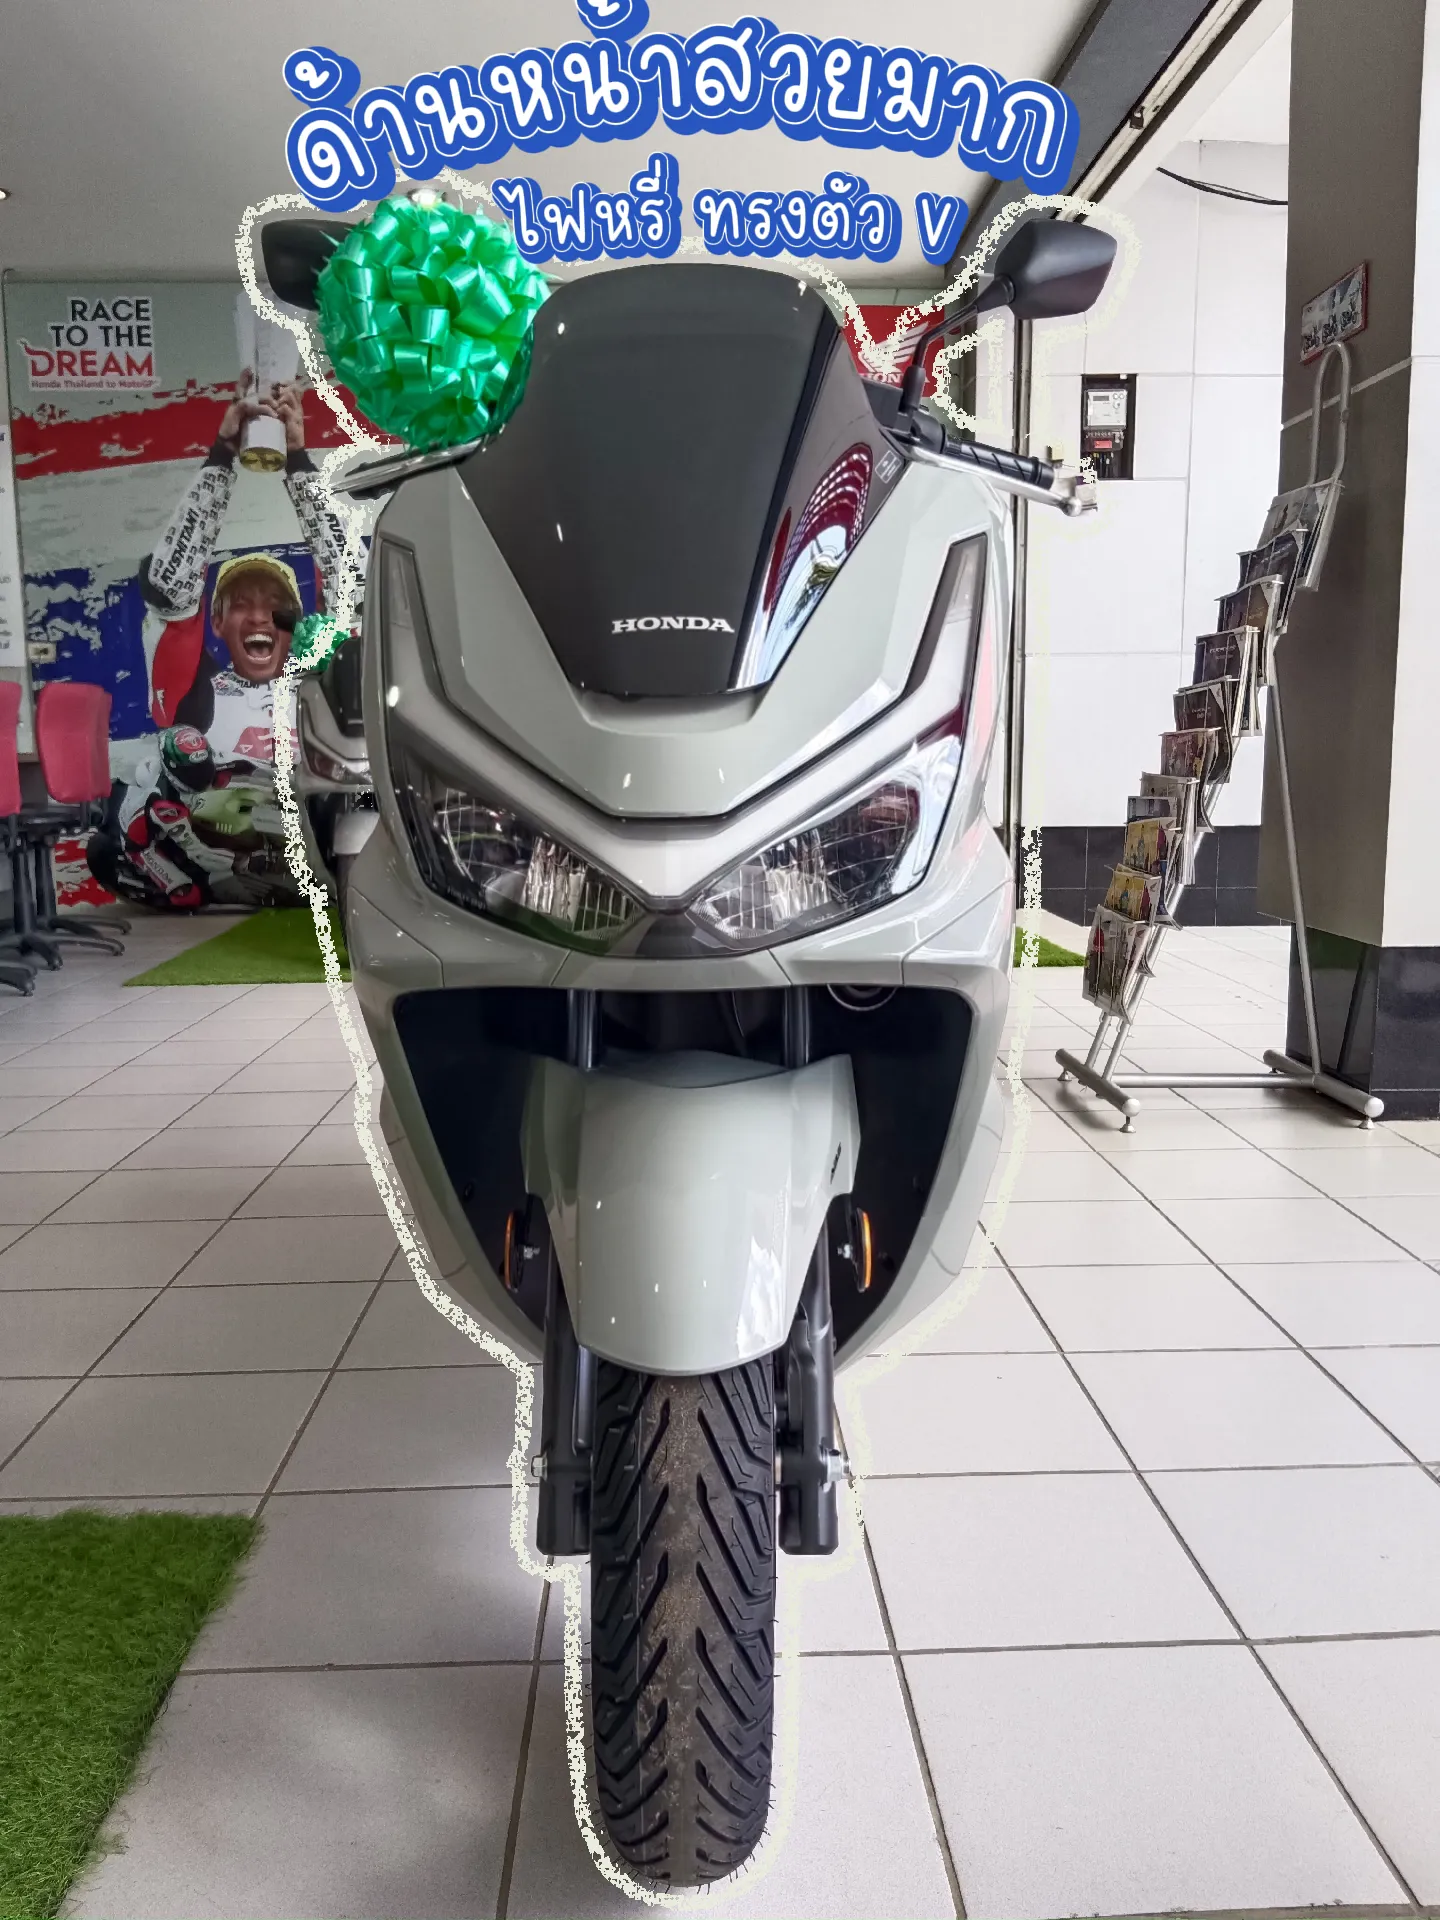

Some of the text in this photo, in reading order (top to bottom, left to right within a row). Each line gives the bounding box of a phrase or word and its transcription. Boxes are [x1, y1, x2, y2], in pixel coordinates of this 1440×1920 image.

[71, 299, 151, 322] RACE
[50, 324, 152, 347] TO THE
[21, 340, 153, 377] DREAM
[611, 616, 735, 634] HONDA
